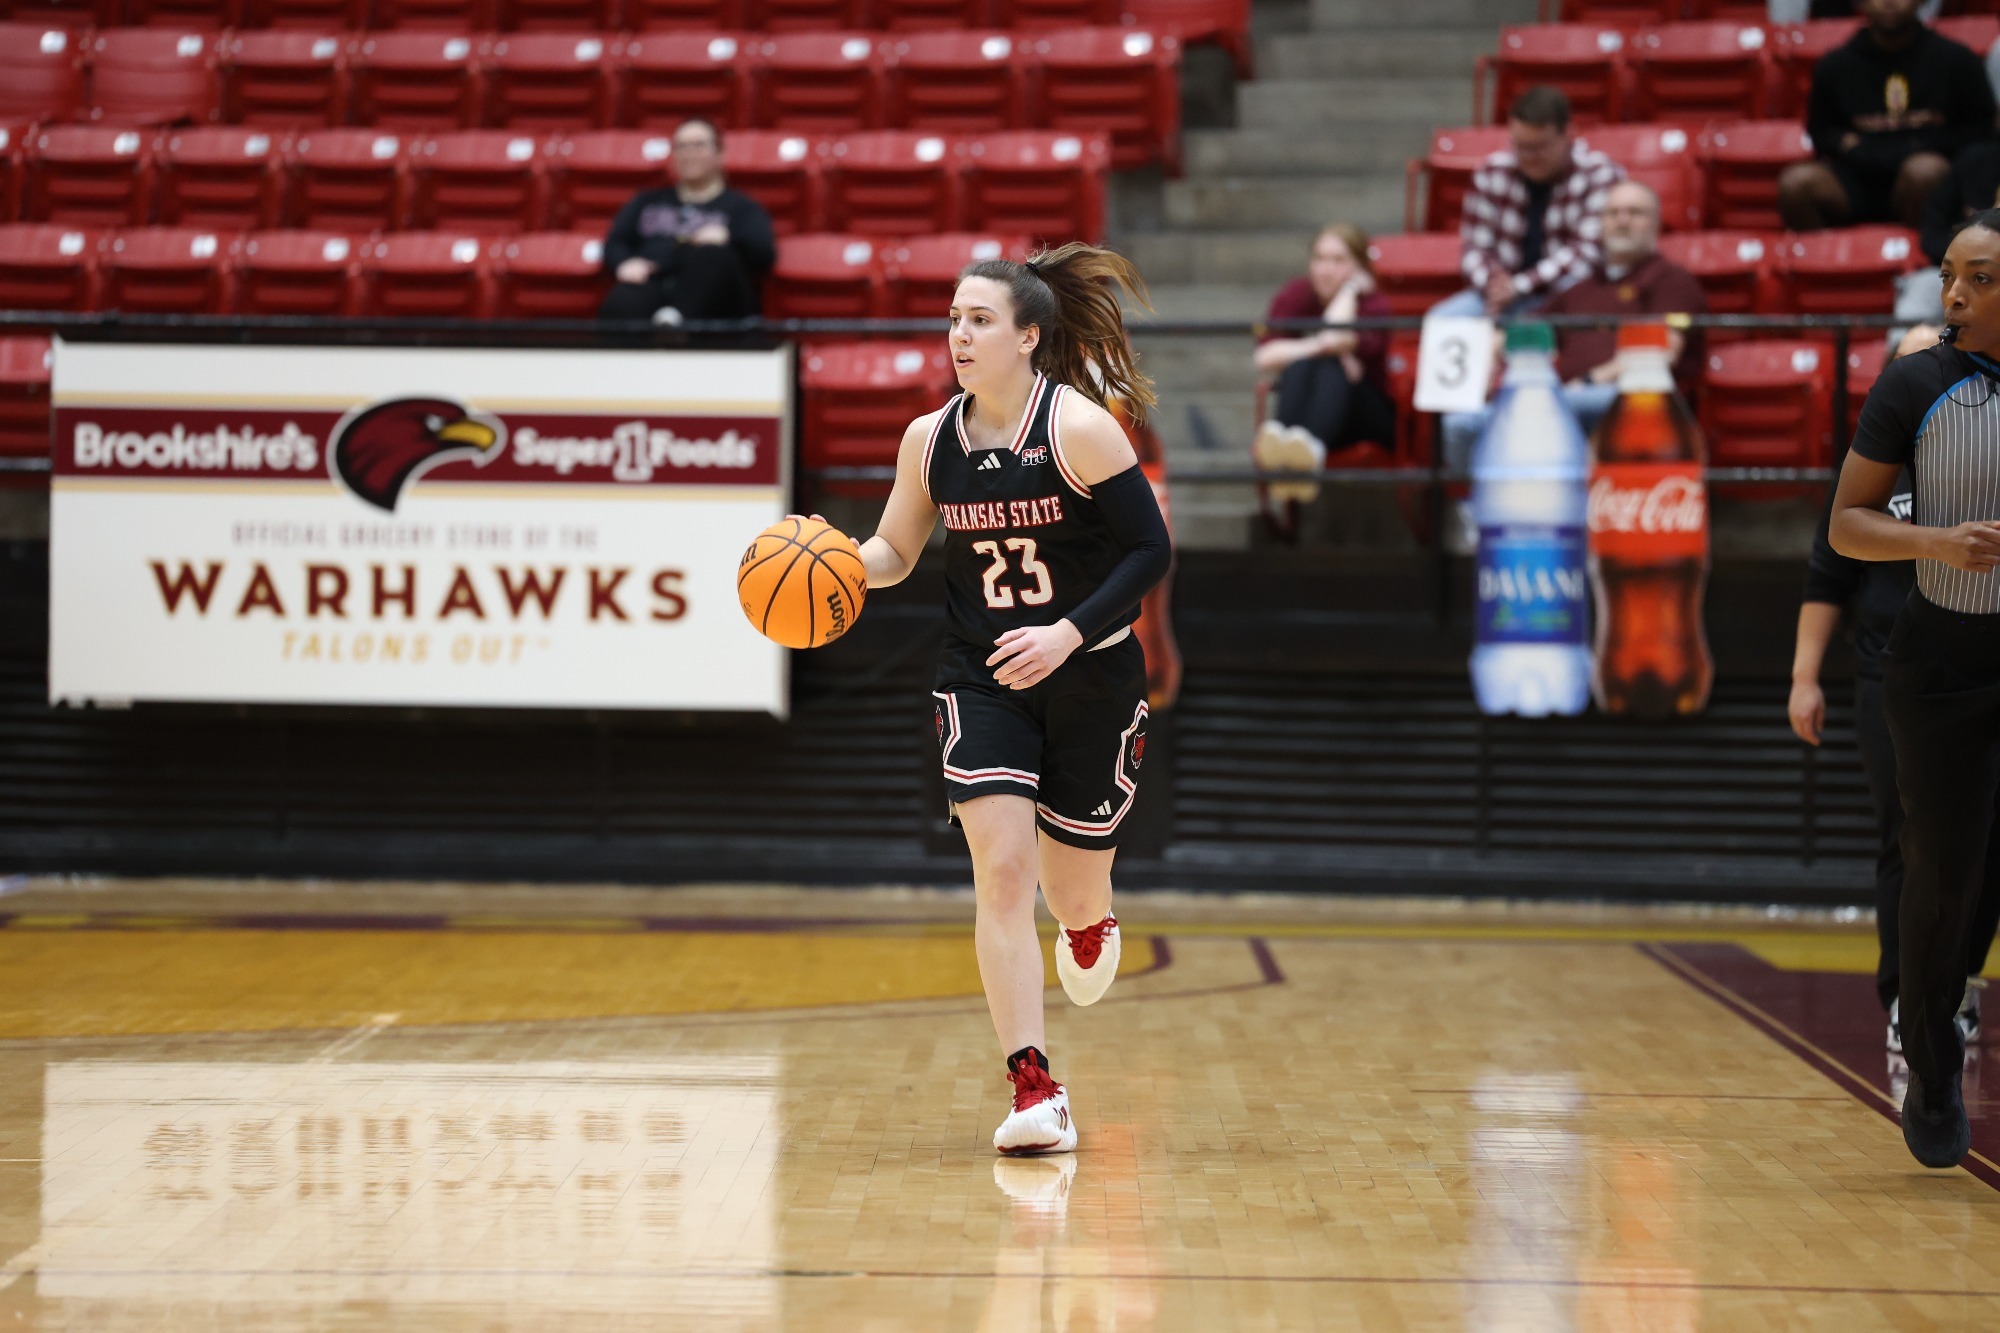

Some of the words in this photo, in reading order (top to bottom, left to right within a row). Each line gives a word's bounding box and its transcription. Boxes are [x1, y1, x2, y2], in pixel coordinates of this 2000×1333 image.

[1436, 336, 1469, 388] 3
[74, 421, 318, 471] Brookshire's
[513, 427, 614, 475] Super
[650, 429, 756, 468] Foods
[1010, 495, 1063, 528] STATE
[150, 561, 691, 622] WARHAWKS
[972, 537, 1054, 609] 23
[823, 590, 846, 642] lson
[281, 630, 429, 664] TALONS
[451, 633, 525, 666] OUT
